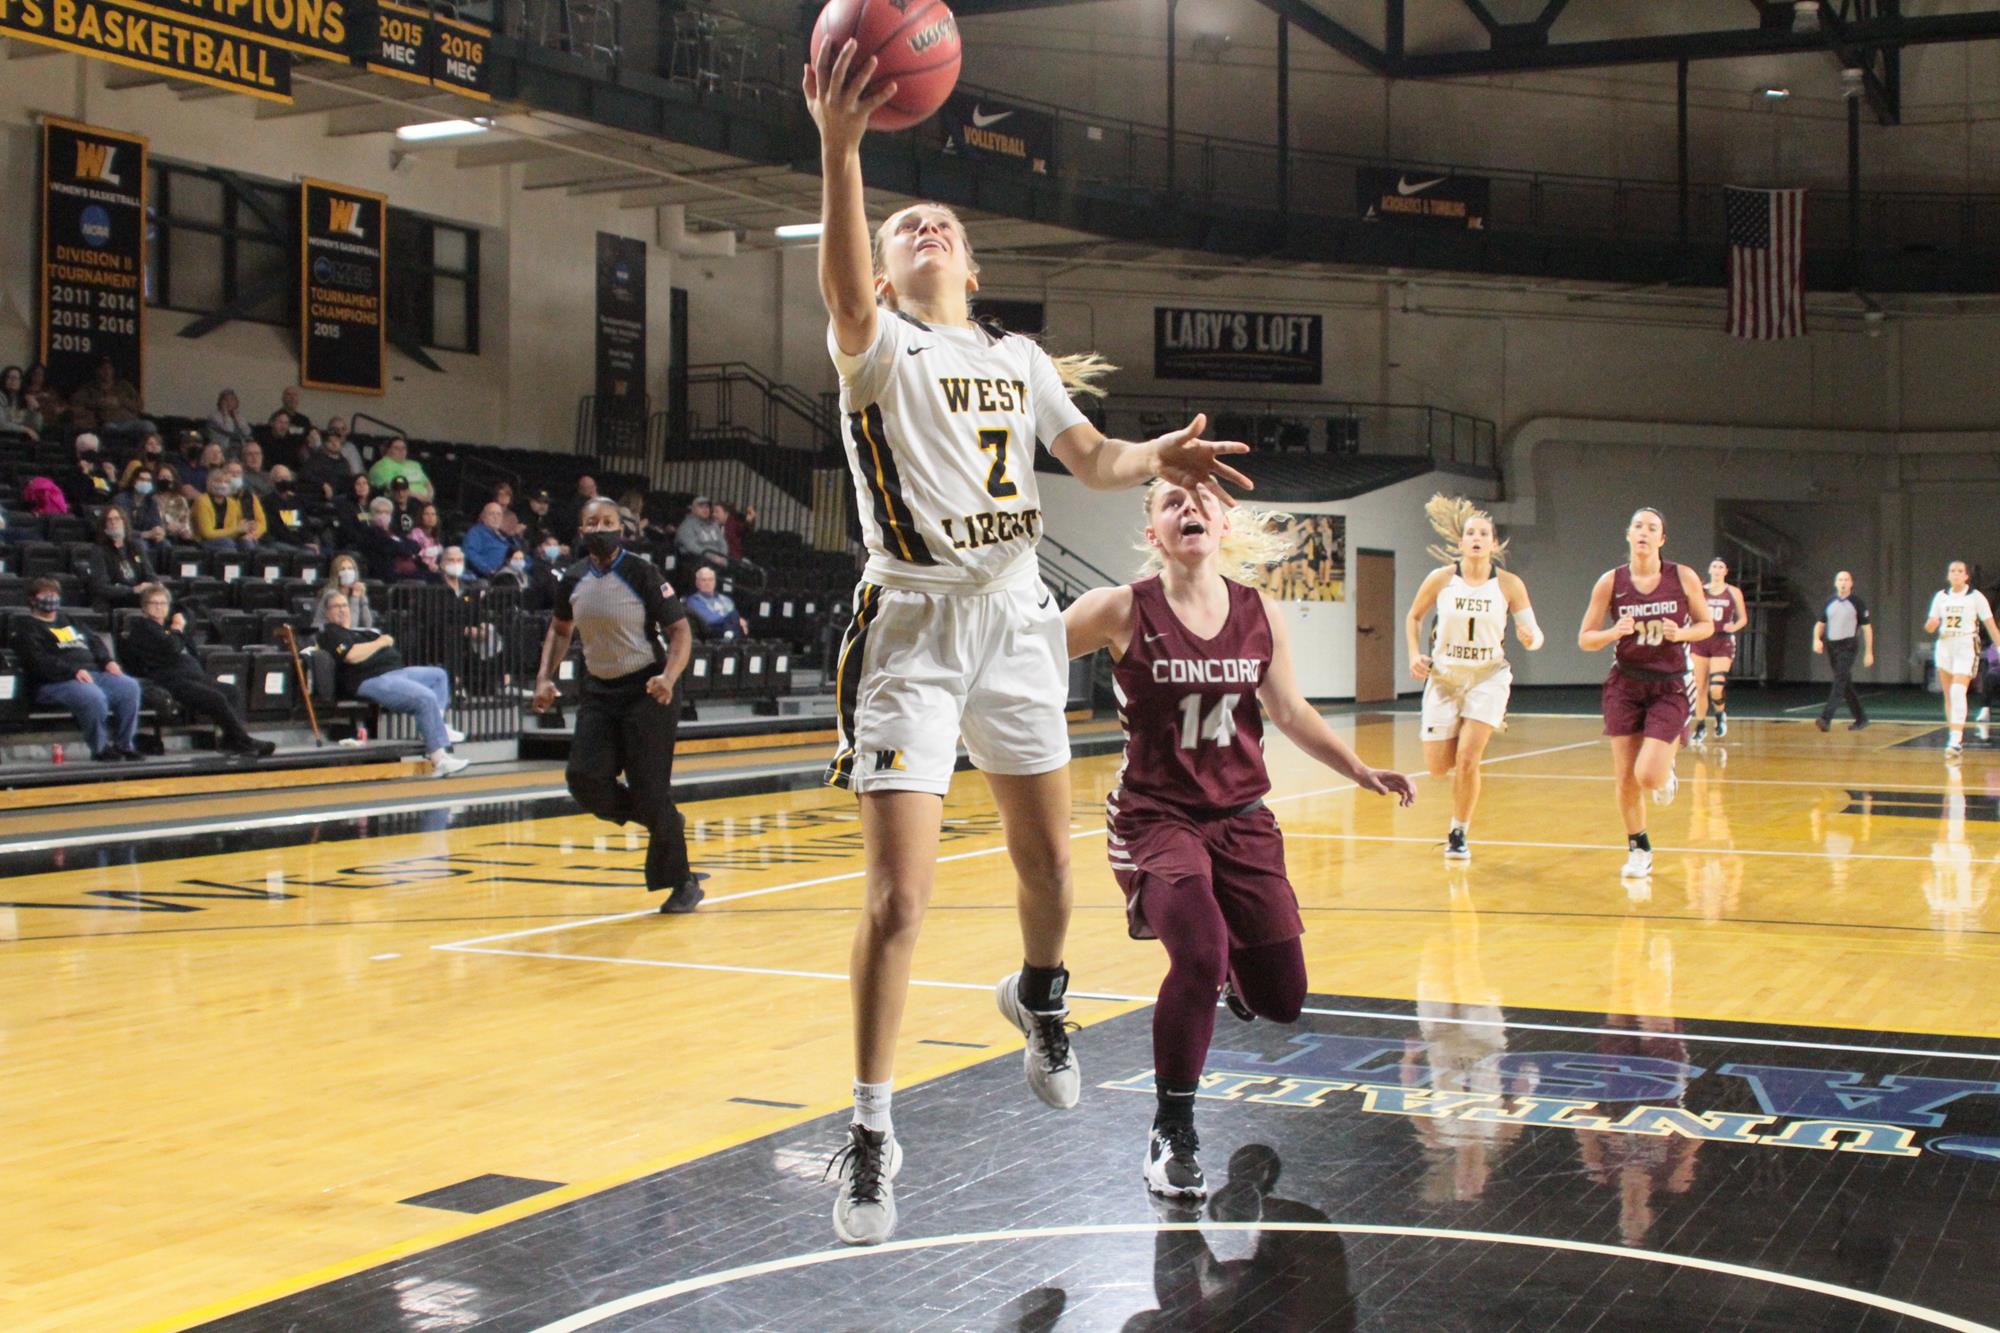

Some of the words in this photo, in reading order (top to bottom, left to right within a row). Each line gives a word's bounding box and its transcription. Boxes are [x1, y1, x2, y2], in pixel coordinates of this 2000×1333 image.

[53, 0, 275, 86] BASKETBALL
[379, 15, 422, 46] 2015
[382, 41, 416, 65] MEC
[441, 32, 483, 64] 2016
[446, 58, 477, 81] MEC
[963, 125, 1026, 157] VOLLEYBALL
[75, 139, 120, 185] WL
[329, 197, 364, 237] WL
[57, 245, 119, 269] DIVISION
[48, 263, 137, 288] TOURNAMENT
[52, 285, 90, 305] 2011
[98, 292, 134, 310] 2014
[311, 286, 377, 309] TOURNAMENT
[52, 308, 90, 329] 2015
[98, 315, 134, 335] 2016
[311, 303, 377, 324] CHAMPIONS
[52, 333, 91, 353] 2019
[1165, 310, 1249, 351] LARY'S
[1256, 315, 1313, 354] LOFT
[939, 378, 1027, 414] WEST
[1455, 597, 1492, 612] WEST
[1618, 600, 1678, 617] CONCORD
[1466, 616, 1475, 642] 1
[1634, 619, 1664, 647] 10
[1946, 616, 1963, 629] 22
[1446, 643, 1494, 661] LIBERTY
[1152, 658, 1261, 683] CONCORD
[1178, 693, 1241, 750] 14
[875, 749, 906, 772] WL
